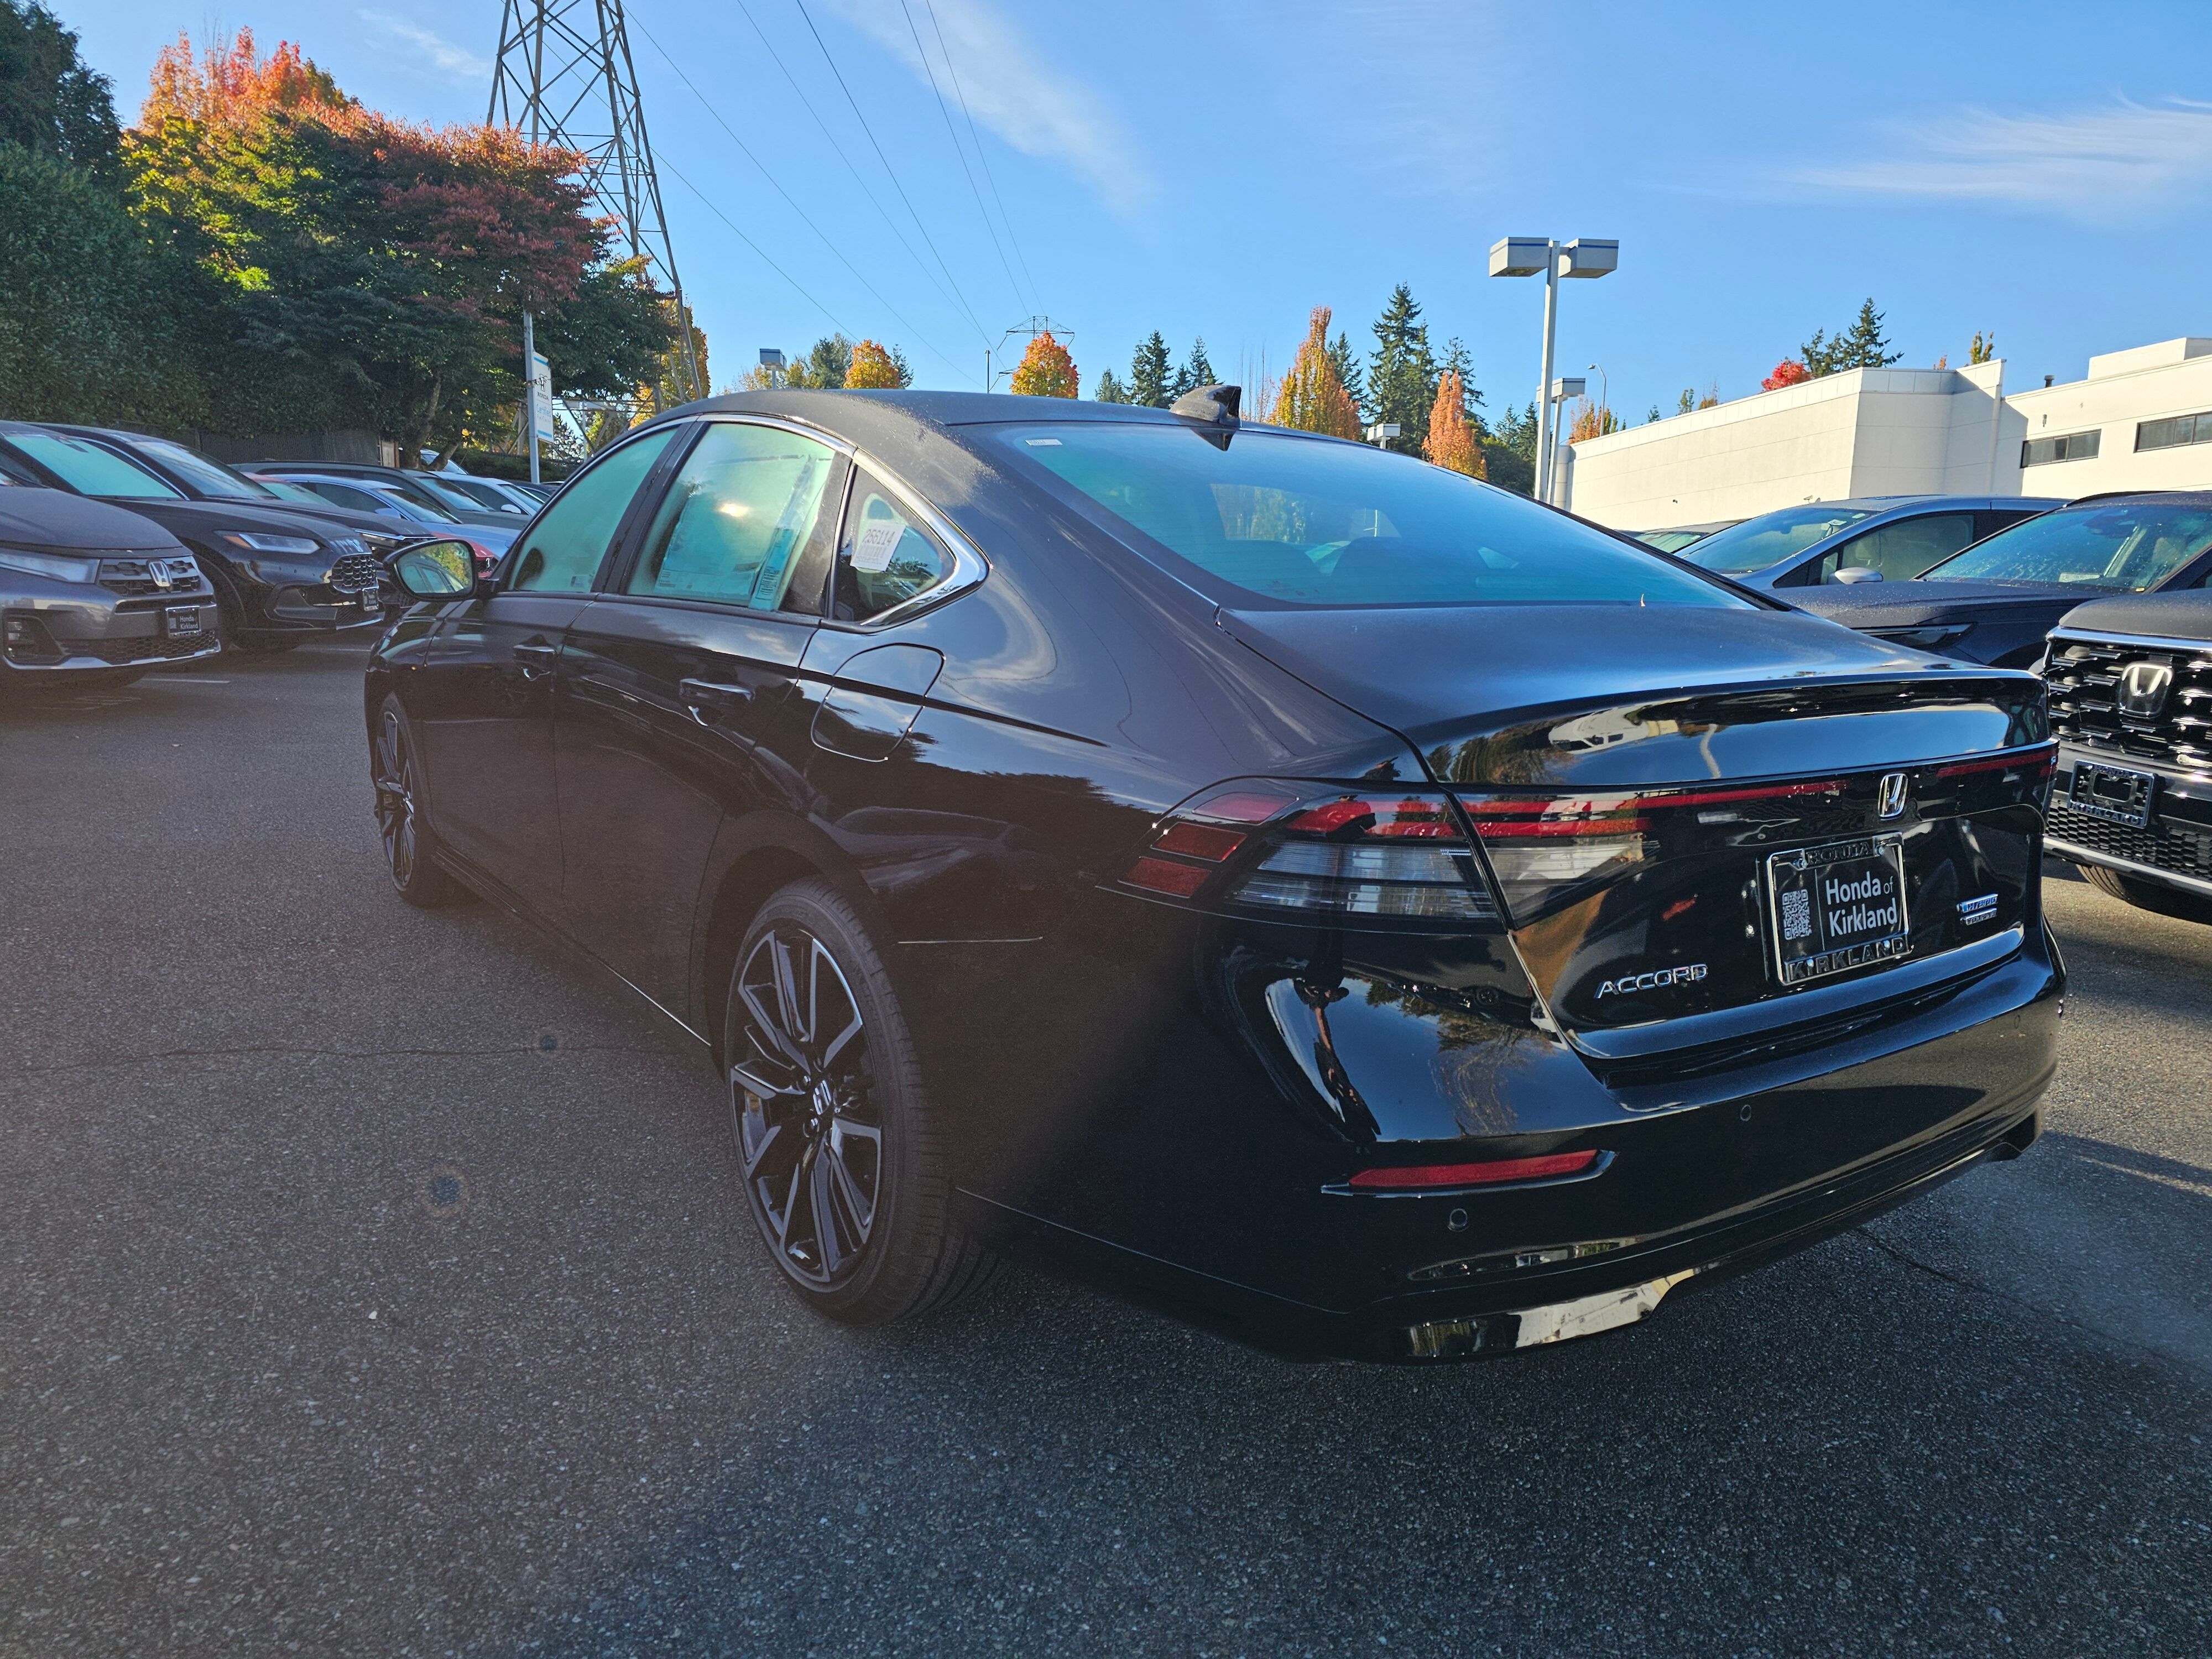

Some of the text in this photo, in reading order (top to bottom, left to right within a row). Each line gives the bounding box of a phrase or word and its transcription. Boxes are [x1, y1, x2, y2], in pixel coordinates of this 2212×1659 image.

[1806, 841, 1873, 864] HONDA
[1825, 870, 1893, 905] Honda of
[1829, 897, 1898, 937] Kirkland
[1789, 937, 1904, 980] KIRKLAND
[1593, 963, 1708, 999] ACCORD
